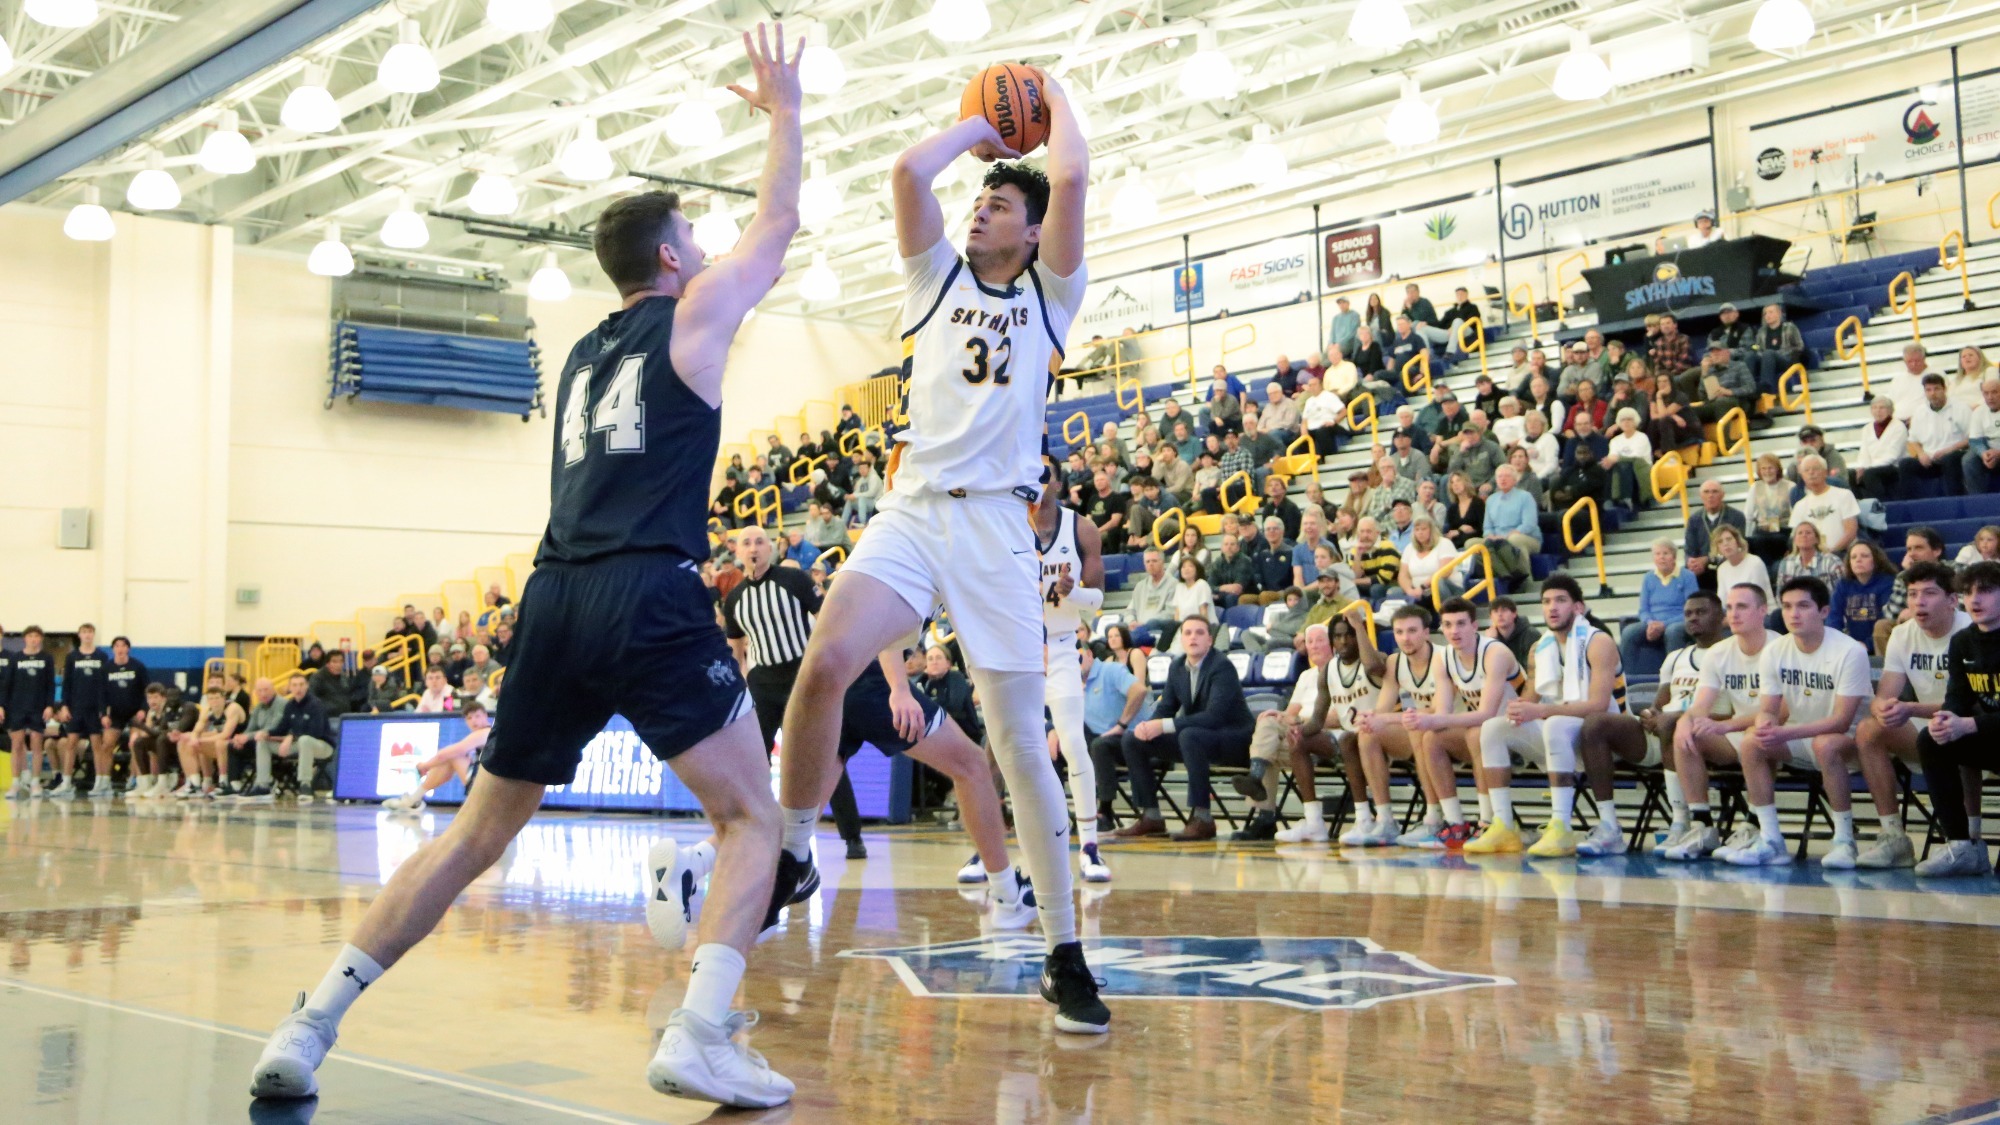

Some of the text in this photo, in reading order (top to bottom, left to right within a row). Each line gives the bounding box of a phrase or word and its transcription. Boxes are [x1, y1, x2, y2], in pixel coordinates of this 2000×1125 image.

[994, 74, 1017, 139] Wilson
[1023, 78, 1043, 123] NCAA
[1904, 141, 1945, 159] CHOICE
[1793, 159, 1805, 171] By
[1657, 181, 1696, 196] CHANNELS
[1538, 192, 1601, 220] HUTTON
[1331, 233, 1374, 253] SERIOUS
[1337, 247, 1368, 264] TEXAS
[1624, 275, 1716, 311] SKYHAWKS
[962, 336, 1013, 388] 32
[561, 352, 648, 470] 44
[1910, 652, 1934, 671] FORT
